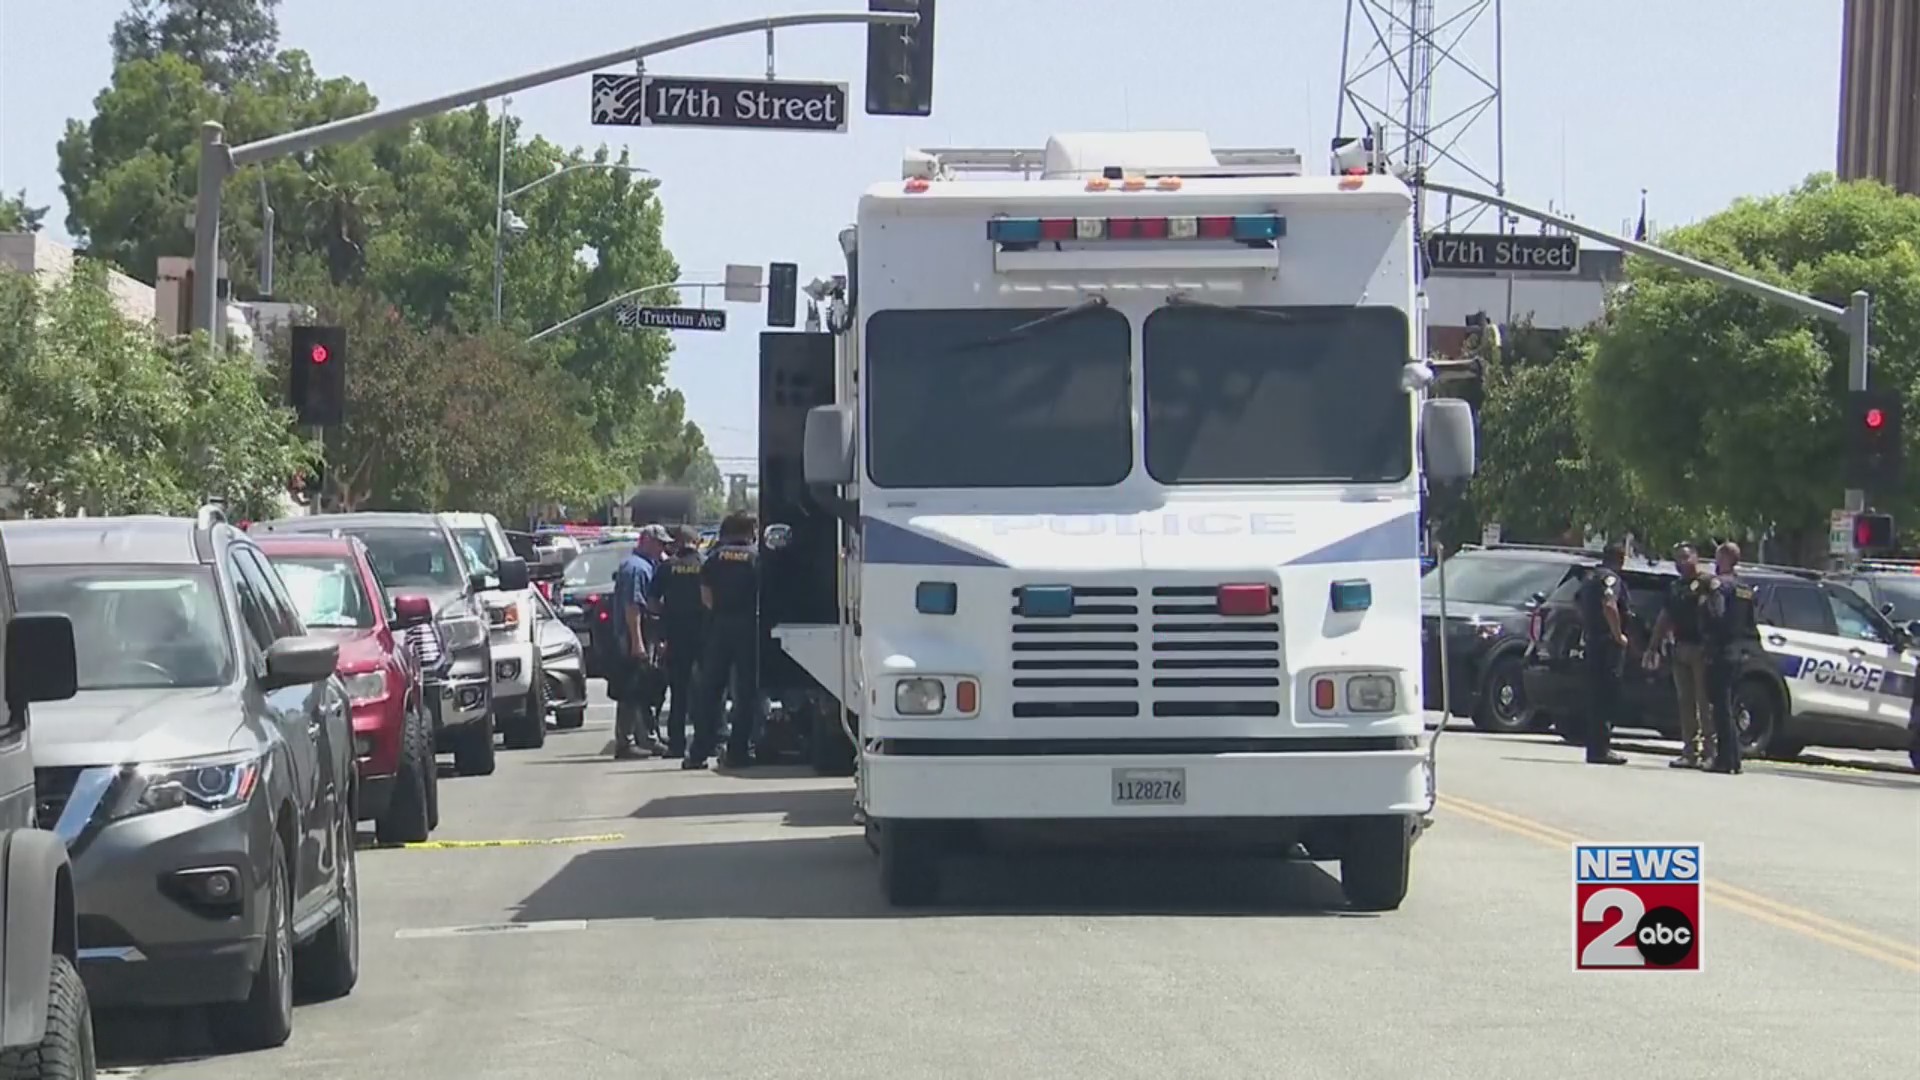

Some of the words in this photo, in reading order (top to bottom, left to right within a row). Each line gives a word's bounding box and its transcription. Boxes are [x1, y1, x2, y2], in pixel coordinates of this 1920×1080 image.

[656, 87, 721, 118] 17th
[735, 90, 837, 122] Street
[1437, 240, 1484, 263] 17th
[1495, 242, 1571, 265] Street
[642, 310, 694, 326] Truxtun
[698, 313, 721, 327] Ave
[992, 511, 1297, 536] POLICE
[718, 551, 749, 561] POLICE
[671, 565, 701, 575] POLICE
[1800, 657, 1883, 691] POLICE
[1117, 780, 1181, 801] 1128276
